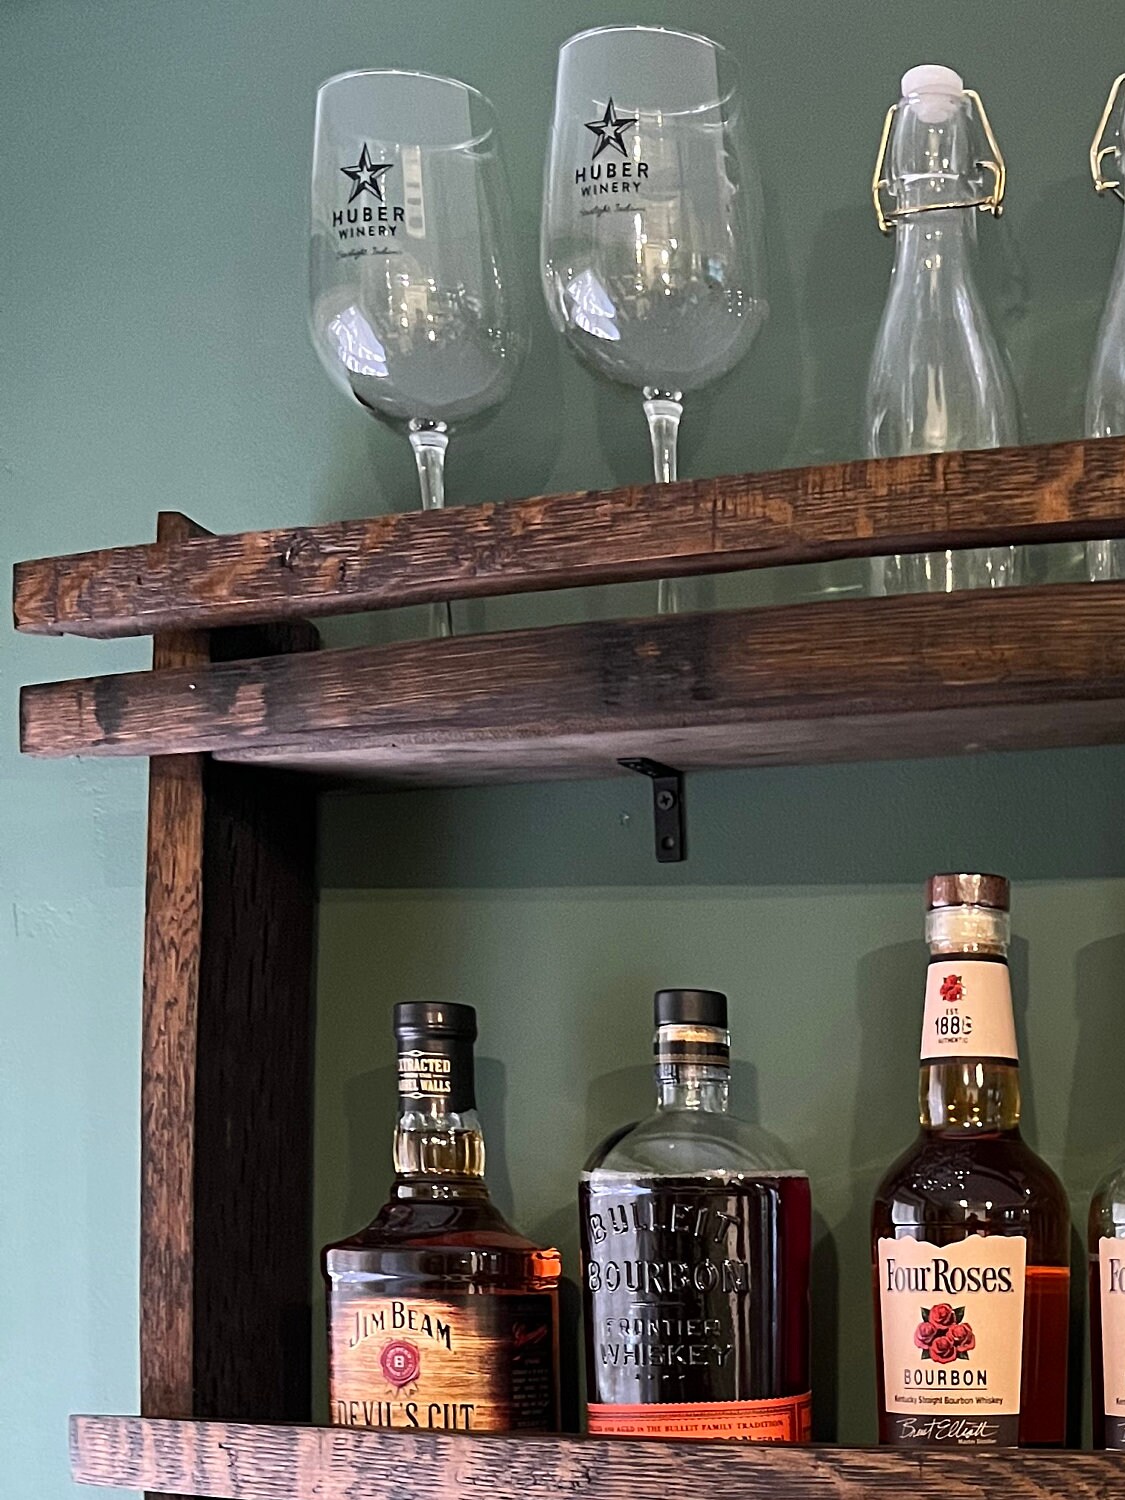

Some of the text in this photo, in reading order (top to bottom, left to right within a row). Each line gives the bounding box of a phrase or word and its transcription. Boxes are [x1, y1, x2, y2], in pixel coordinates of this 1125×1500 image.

[575, 162, 649, 184] HUBER
[581, 181, 641, 197] WINERY
[332, 206, 405, 228] HUBER
[338, 225, 397, 240] WINERY
[420, 1079, 451, 1093] WALLS
[590, 1201, 741, 1245] BULLEIT
[588, 1259, 751, 1294] BOURBON
[886, 1258, 1013, 1295] Four Roses
[349, 1300, 452, 1351] JIM BEAM
[606, 1317, 721, 1338] FRONTIER
[600, 1343, 733, 1367] WHISKEY
[903, 1368, 988, 1386] BOURBON
[944, 1396, 974, 1405] Bourbon
[975, 1397, 1004, 1406] Whiskey
[701, 1423, 732, 1431] FAMILY
[736, 1419, 784, 1430] TRADITION
